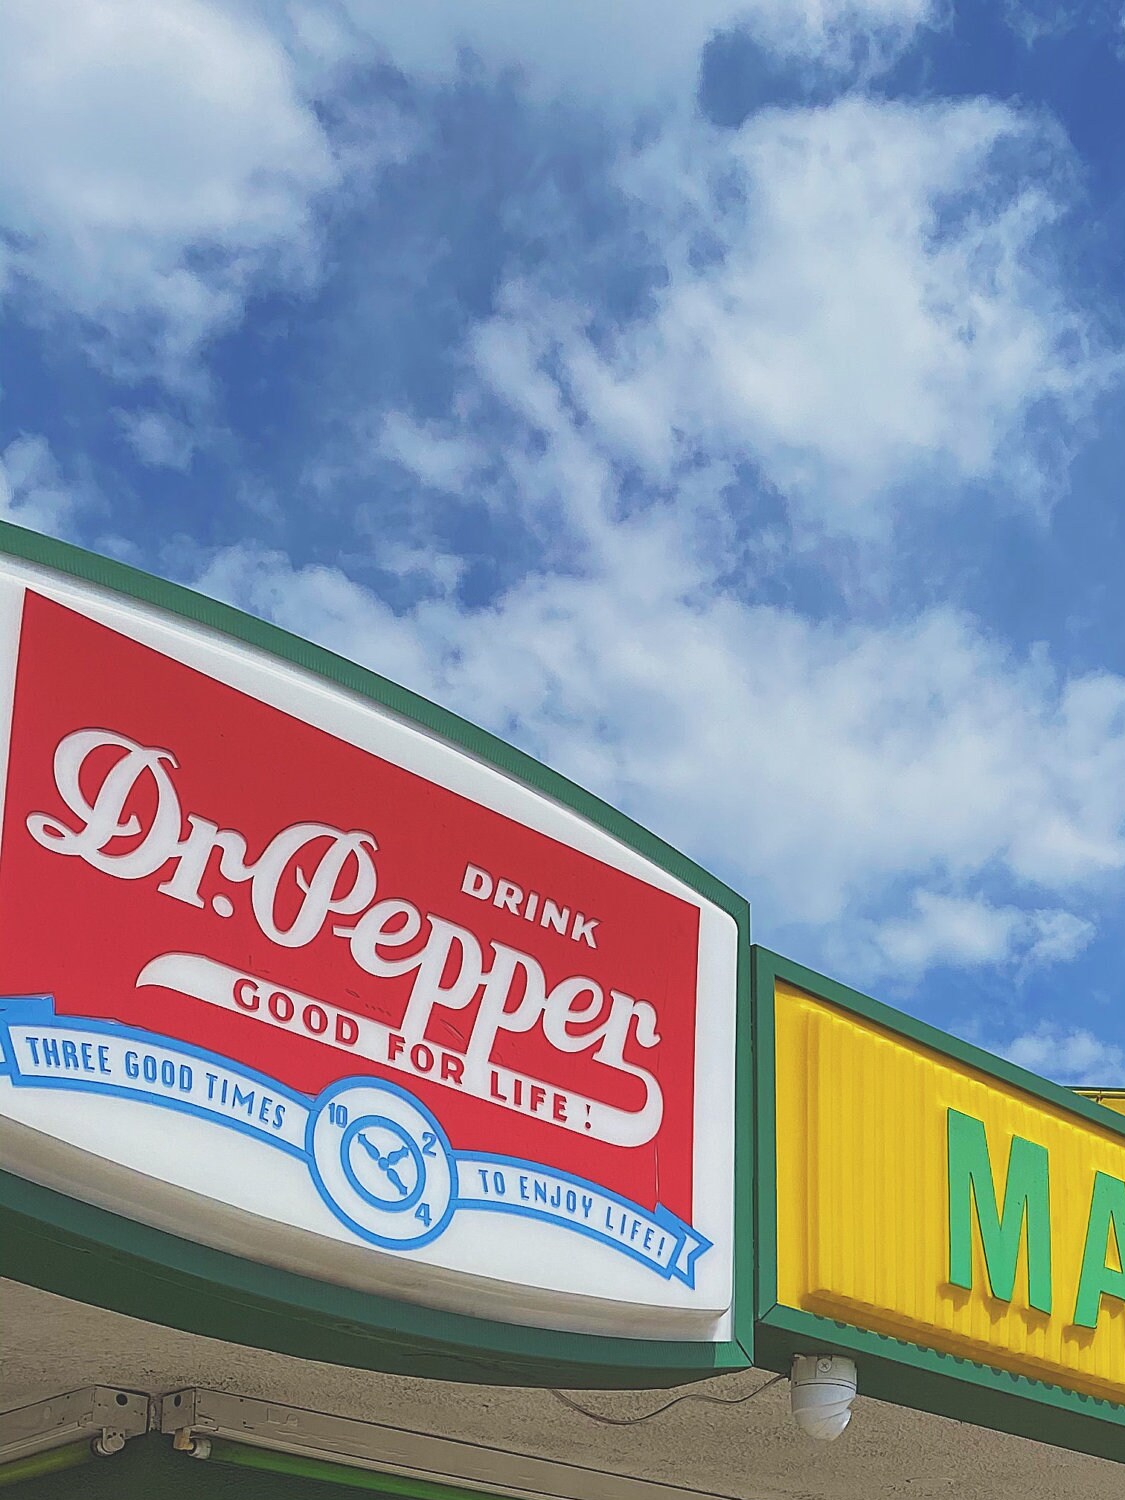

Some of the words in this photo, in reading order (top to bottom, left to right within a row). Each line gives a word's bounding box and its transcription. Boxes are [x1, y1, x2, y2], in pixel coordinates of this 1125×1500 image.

[460, 862, 600, 950] DRINK
[233, 978, 359, 1046] GOOD
[388, 1032, 465, 1085] FOR
[25, 1036, 112, 1074] THREE
[125, 1051, 193, 1092] GOOD
[205, 1072, 286, 1131] TIMES
[328, 1102, 348, 1128] 10
[421, 1131, 437, 1156] 2
[414, 1203, 432, 1228] 4
[478, 1168, 506, 1195] TO
[520, 1176, 593, 1218] ENJOY
[605, 1206, 666, 1258] LIFE!
